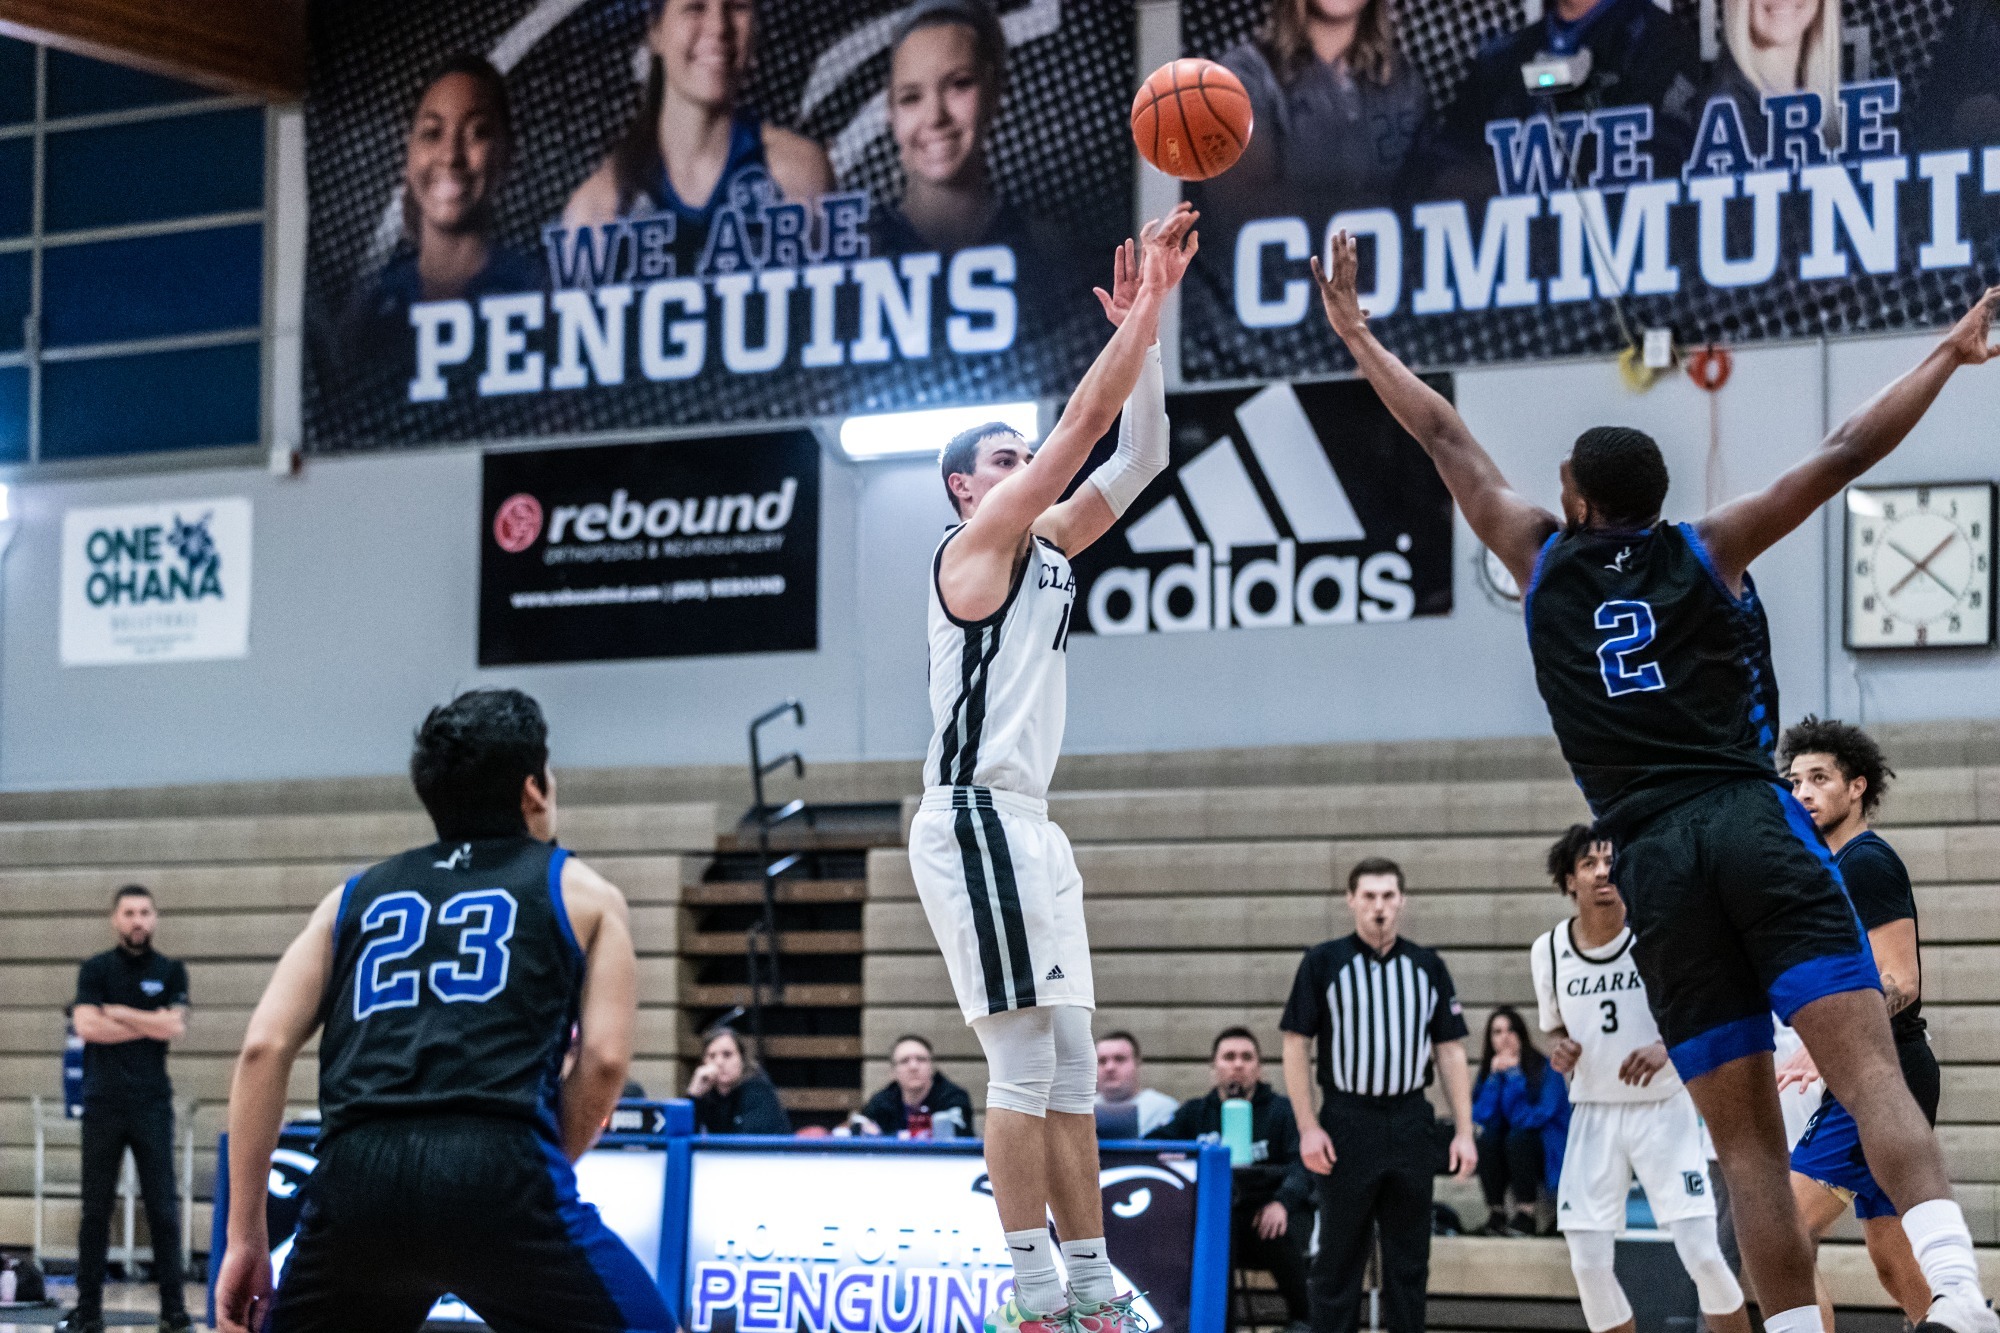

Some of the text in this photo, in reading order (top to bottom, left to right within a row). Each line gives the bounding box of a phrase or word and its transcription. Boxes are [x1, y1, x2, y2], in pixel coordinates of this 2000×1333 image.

[1486, 78, 1900, 198] WE ARE
[541, 190, 871, 289] WE ARE
[1234, 147, 2000, 328] COMMUNI
[407, 244, 1019, 401] PENGUINS
[85, 525, 163, 565] ONE
[546, 476, 799, 545] rebound
[85, 554, 224, 608] OHANA
[1052, 603, 1069, 652] 1
[1087, 537, 1416, 636] adidas
[1593, 600, 1667, 697] 2
[353, 887, 519, 1021] 23
[1566, 971, 1641, 997] CLARK
[1600, 999, 1619, 1034] 3
